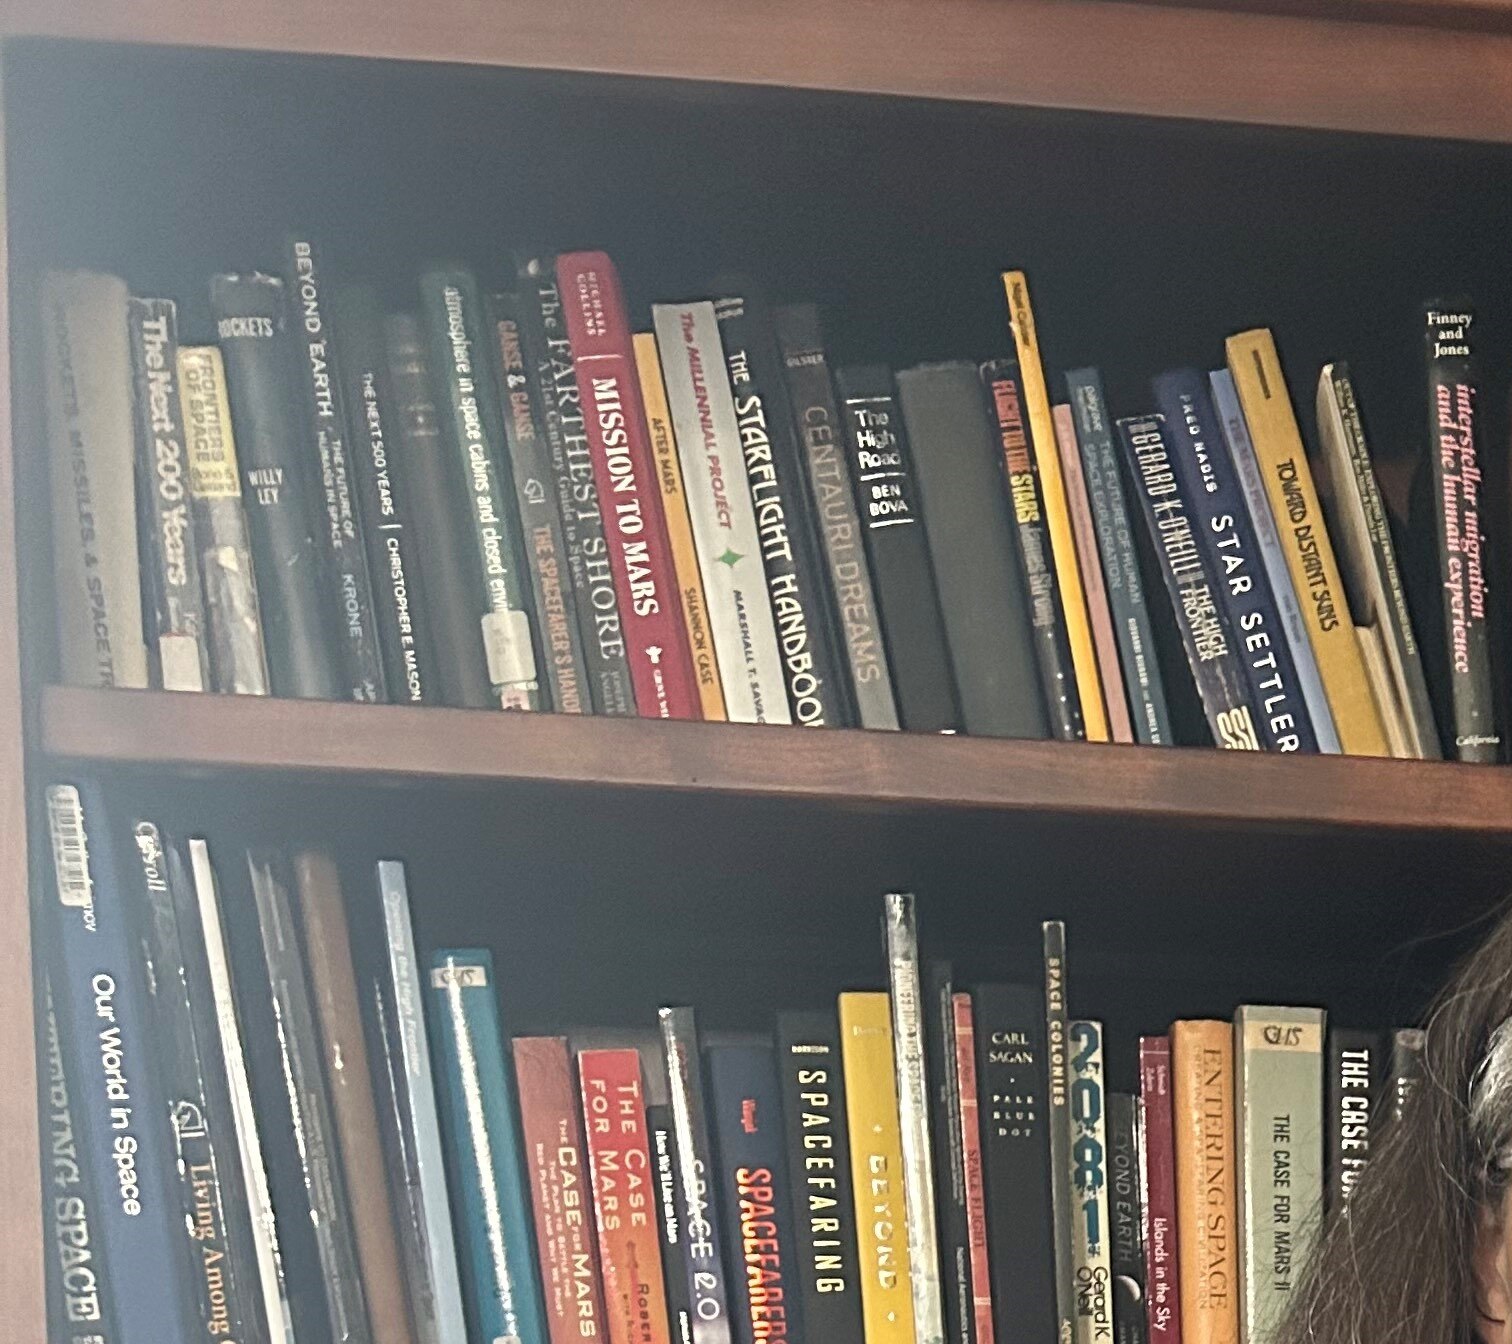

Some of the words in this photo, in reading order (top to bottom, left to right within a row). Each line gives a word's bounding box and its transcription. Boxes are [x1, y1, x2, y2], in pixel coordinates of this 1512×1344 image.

[1427, 312, 1472, 327] Finney
[1439, 327, 1464, 340] and
[727, 349, 750, 385] THE
[1434, 342, 1470, 358] Jones
[361, 372, 376, 398] THE
[365, 401, 382, 438] NEXT
[589, 374, 637, 495] MISSION
[371, 440, 387, 468] 500
[375, 469, 394, 516] YEARS
[735, 394, 793, 561] STARFLIGHT
[613, 498, 645, 535] TO
[385, 537, 411, 633] CHRISTOPHER
[621, 538, 660, 616] MARS
[1209, 512, 1253, 596] STAR
[1238, 610, 1300, 755] SETTLER
[402, 650, 421, 701] MASON
[91, 972, 118, 1023] Our
[989, 1049, 1033, 1064] SAGAN
[992, 1031, 1030, 1046] CARL
[98, 1026, 128, 1101] World
[109, 1105, 133, 1129] in
[1202, 1047, 1225, 1205] ENTERING
[1273, 1115, 1289, 1143] THE
[110, 1134, 144, 1217] Space
[797, 1069, 846, 1295] SPACEFARING
[1273, 1150, 1289, 1187] CASE
[1273, 1195, 1289, 1223] FOR
[1206, 1213, 1228, 1308] SPACE
[1273, 1231, 1289, 1274] MARS
[1273, 1281, 1289, 1290] II
